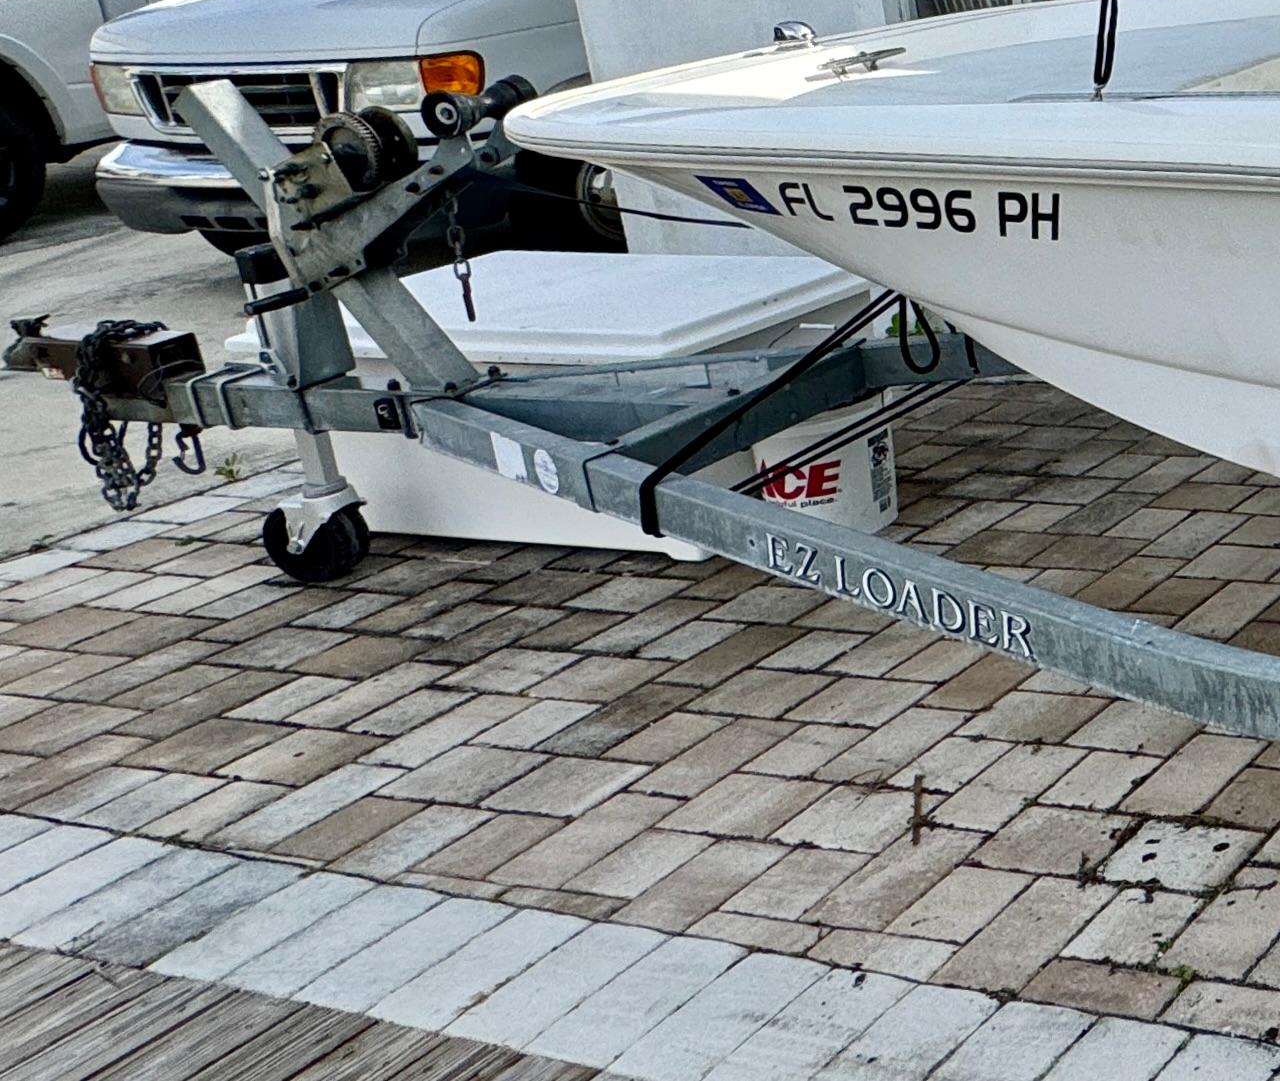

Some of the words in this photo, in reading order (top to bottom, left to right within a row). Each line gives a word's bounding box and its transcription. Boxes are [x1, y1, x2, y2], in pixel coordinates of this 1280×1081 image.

[778, 182, 835, 222] FL
[842, 185, 976, 233] 2996
[998, 191, 1061, 241] PH
[765, 532, 821, 586] EZ
[834, 554, 1039, 660] LOADER
